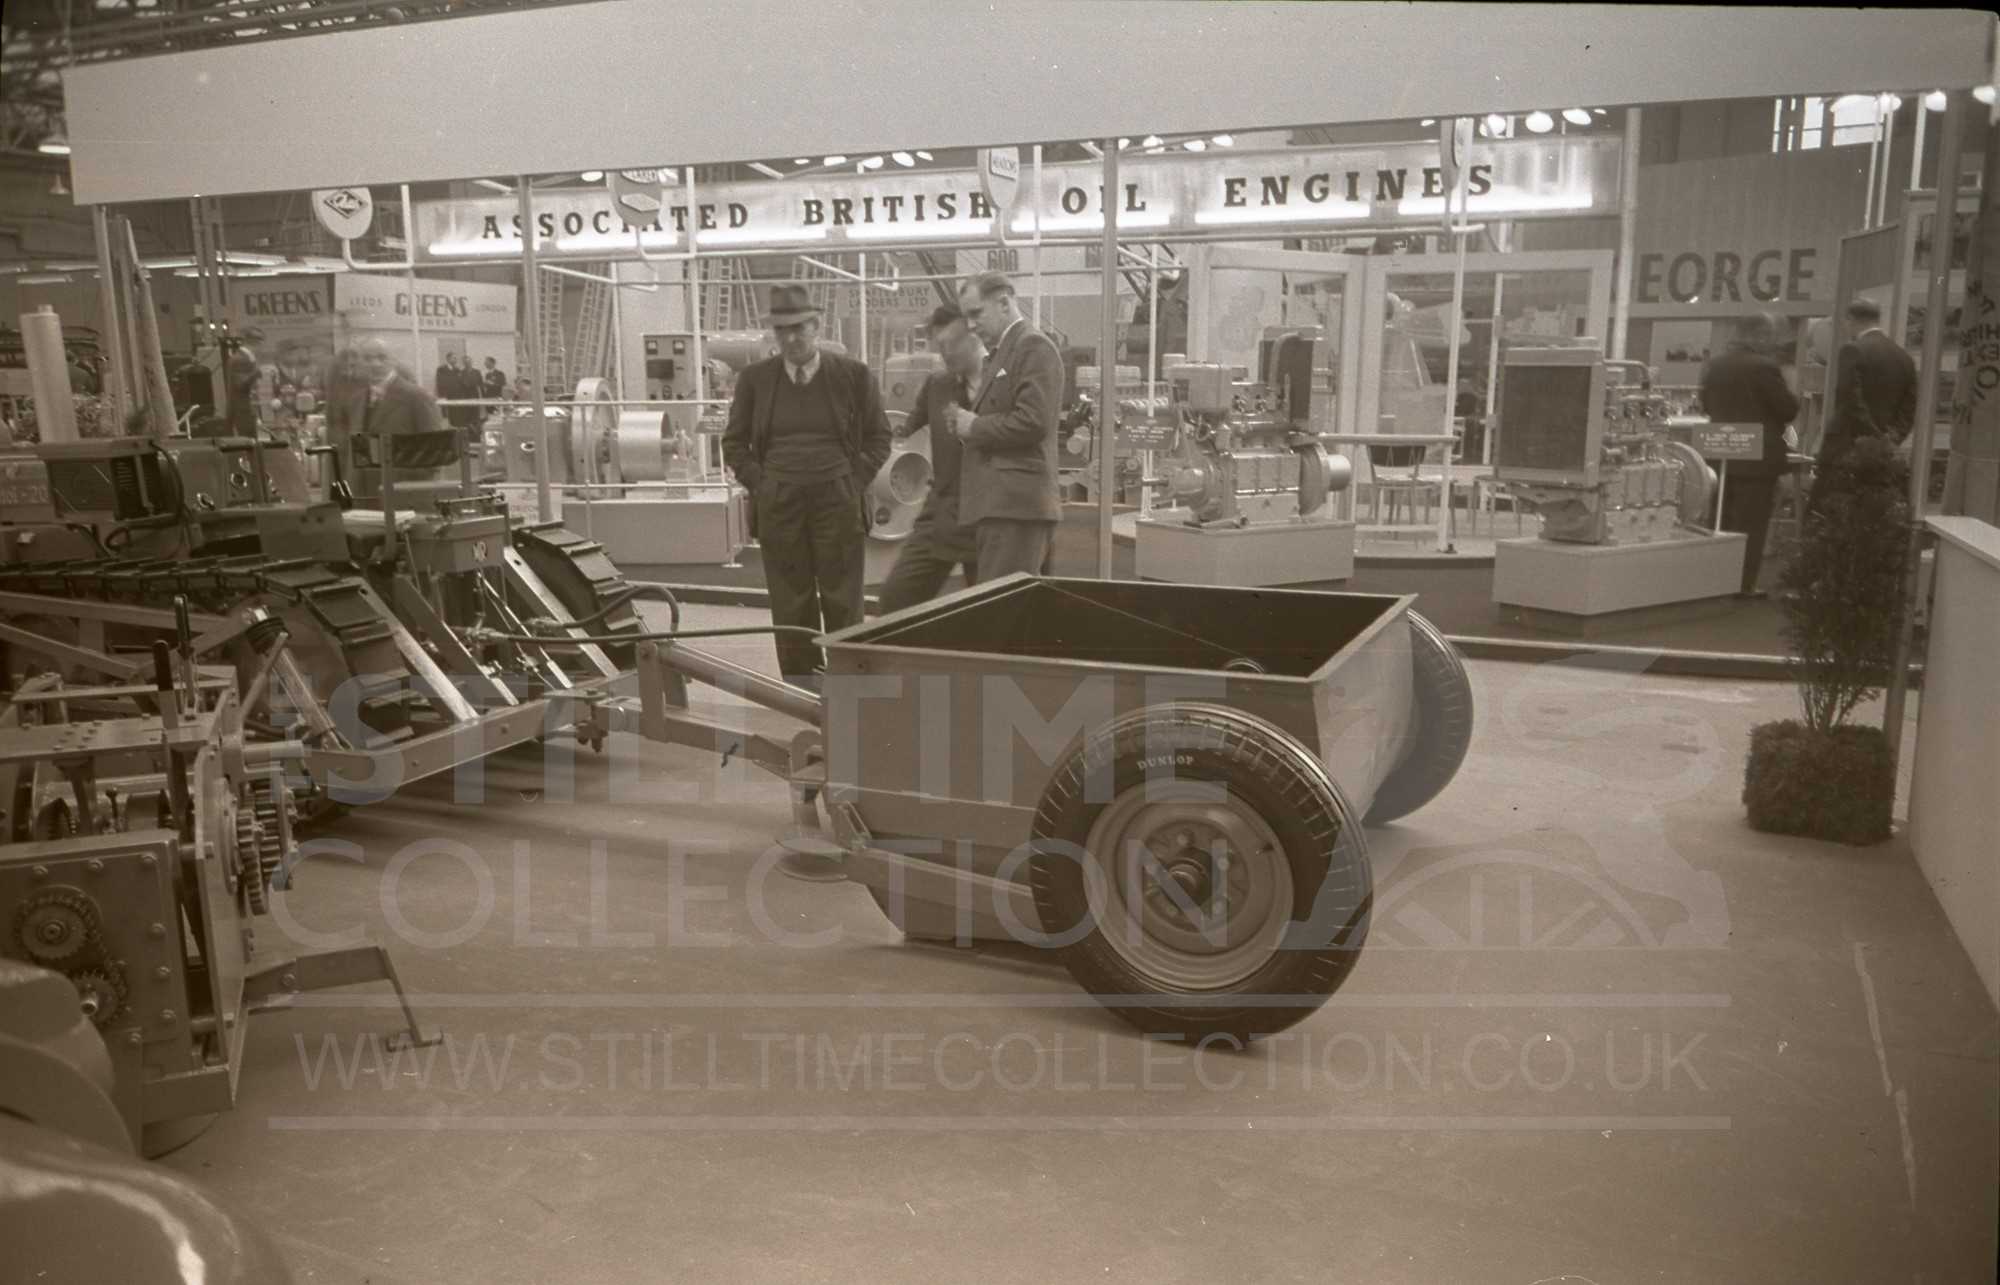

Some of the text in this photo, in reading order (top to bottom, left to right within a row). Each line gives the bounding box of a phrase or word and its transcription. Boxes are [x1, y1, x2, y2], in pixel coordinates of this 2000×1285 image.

[803, 192, 992, 225] BRITISH
[1224, 165, 1492, 207] ENGINES
[244, 291, 321, 315] GREENS
[1136, 755, 1194, 770] DUNLOP
